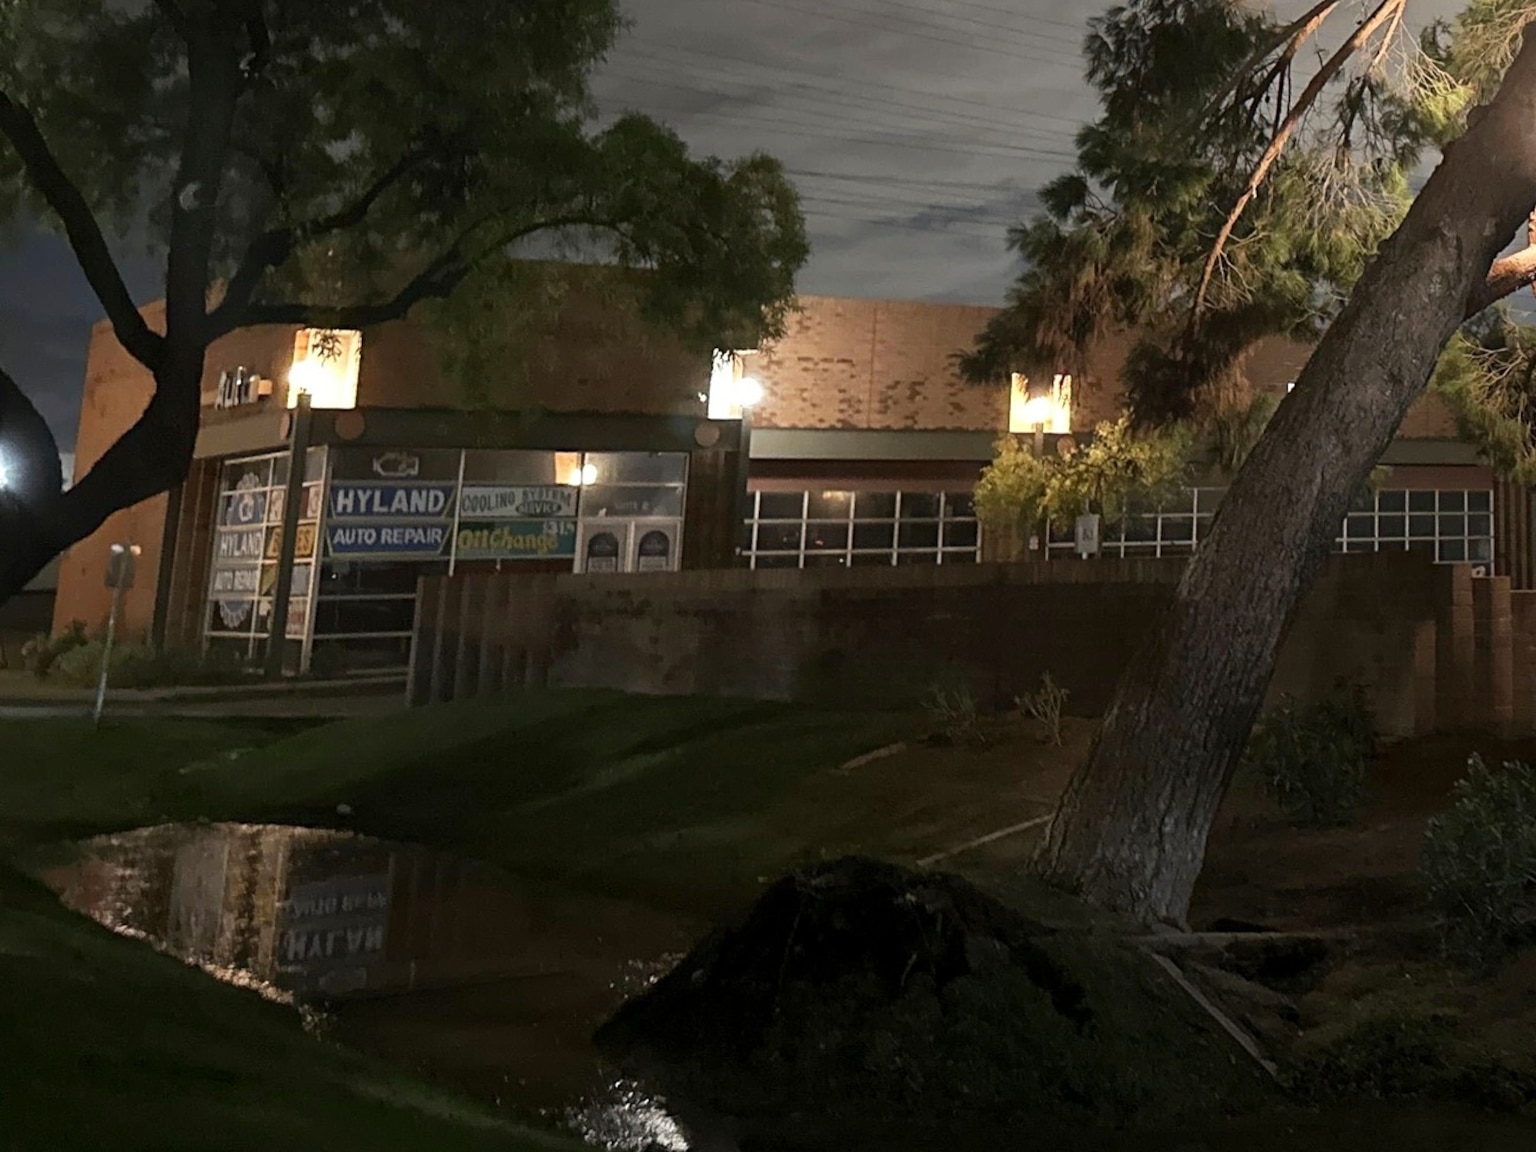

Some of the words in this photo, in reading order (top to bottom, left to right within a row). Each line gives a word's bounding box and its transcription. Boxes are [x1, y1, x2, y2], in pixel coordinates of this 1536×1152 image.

[337, 489, 445, 513] HYLAND
[219, 531, 262, 557] HYLAND
[333, 528, 377, 546] AUTO
[381, 528, 443, 546] REPAIR
